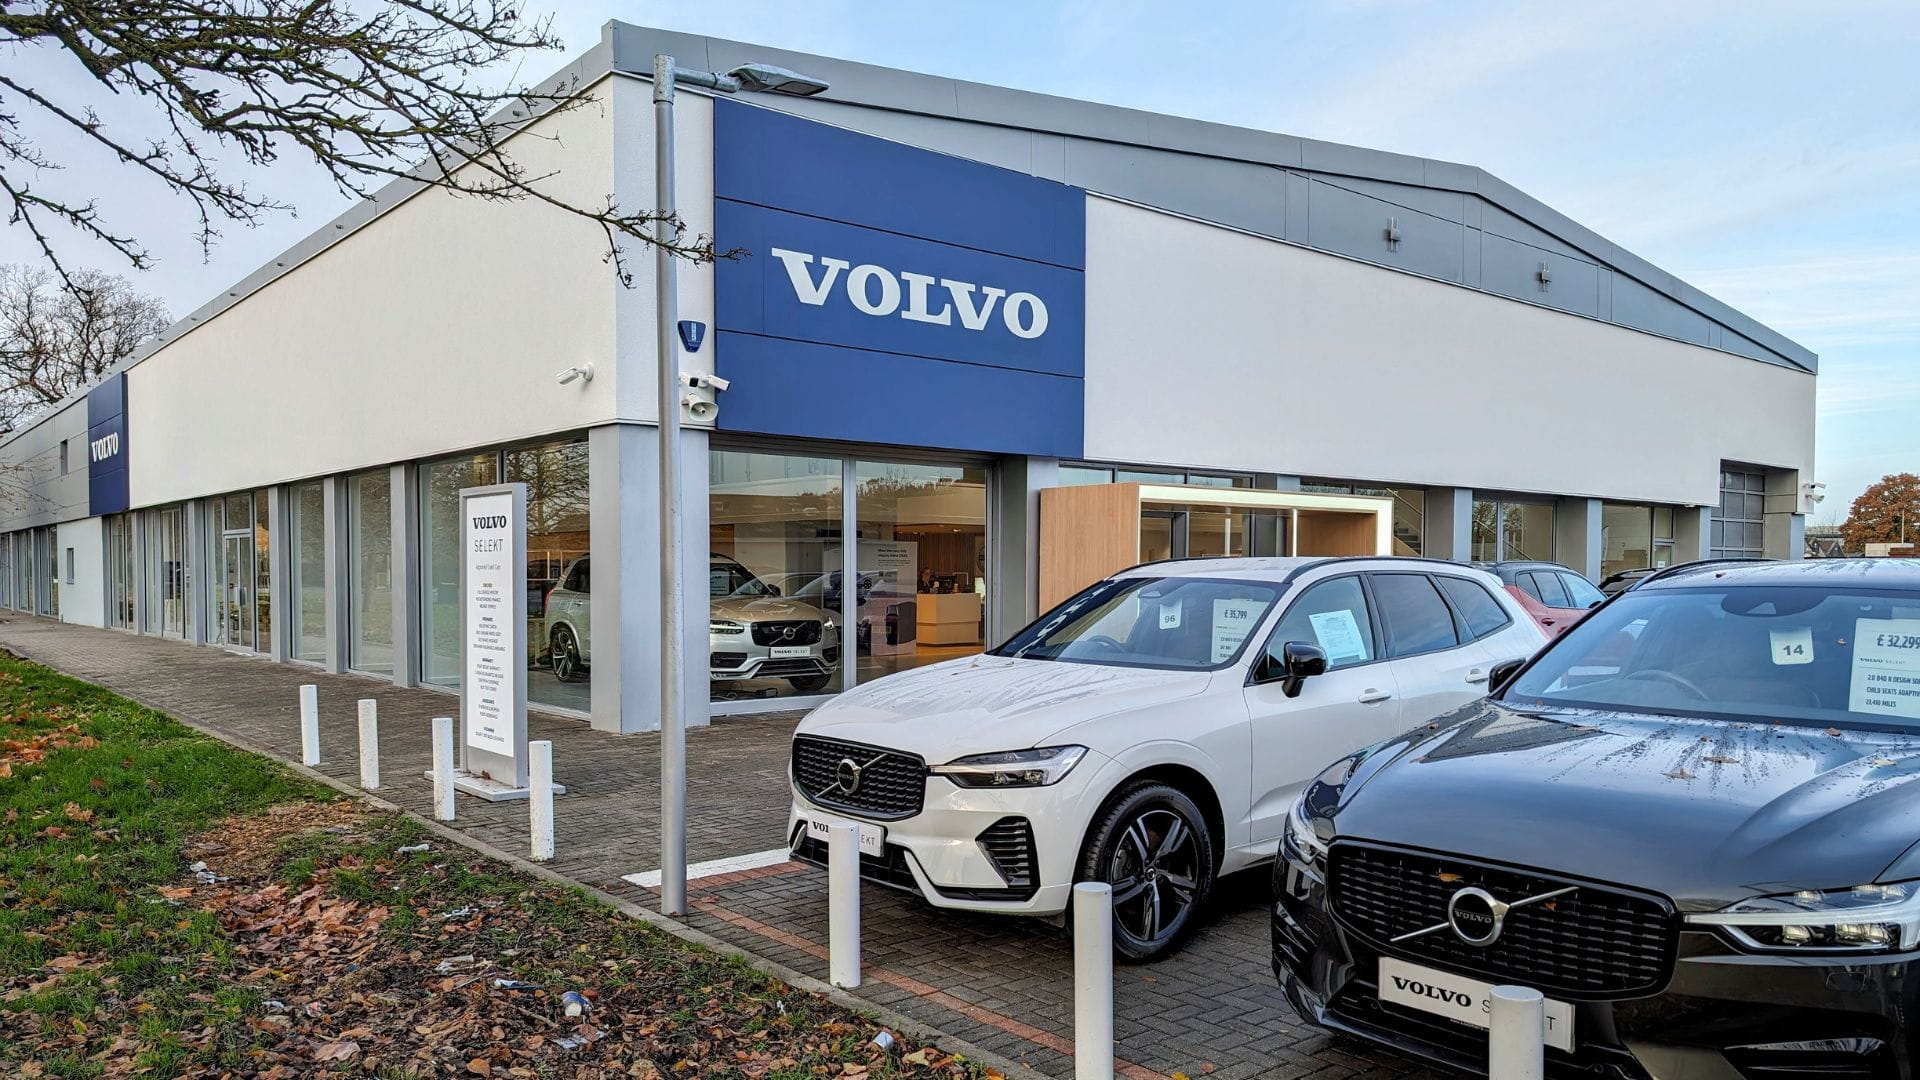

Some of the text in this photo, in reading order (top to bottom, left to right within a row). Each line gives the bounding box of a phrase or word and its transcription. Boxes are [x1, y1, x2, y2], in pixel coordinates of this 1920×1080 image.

[771, 247, 1049, 339] VOLVO
[91, 432, 119, 462] VOLVO
[473, 515, 507, 530] VOLVO
[474, 538, 504, 553] SELEKT
[1164, 615, 1176, 624] 96
[1224, 609, 1229, 619] £
[1877, 634, 1920, 649] £ 32,299
[1783, 645, 1804, 656] 14
[1893, 676, 1911, 684] DESIGN
[1866, 686, 1881, 694] CHILD
[1454, 910, 1492, 924] VOLVO
[1391, 975, 1472, 1008] VOLVO
